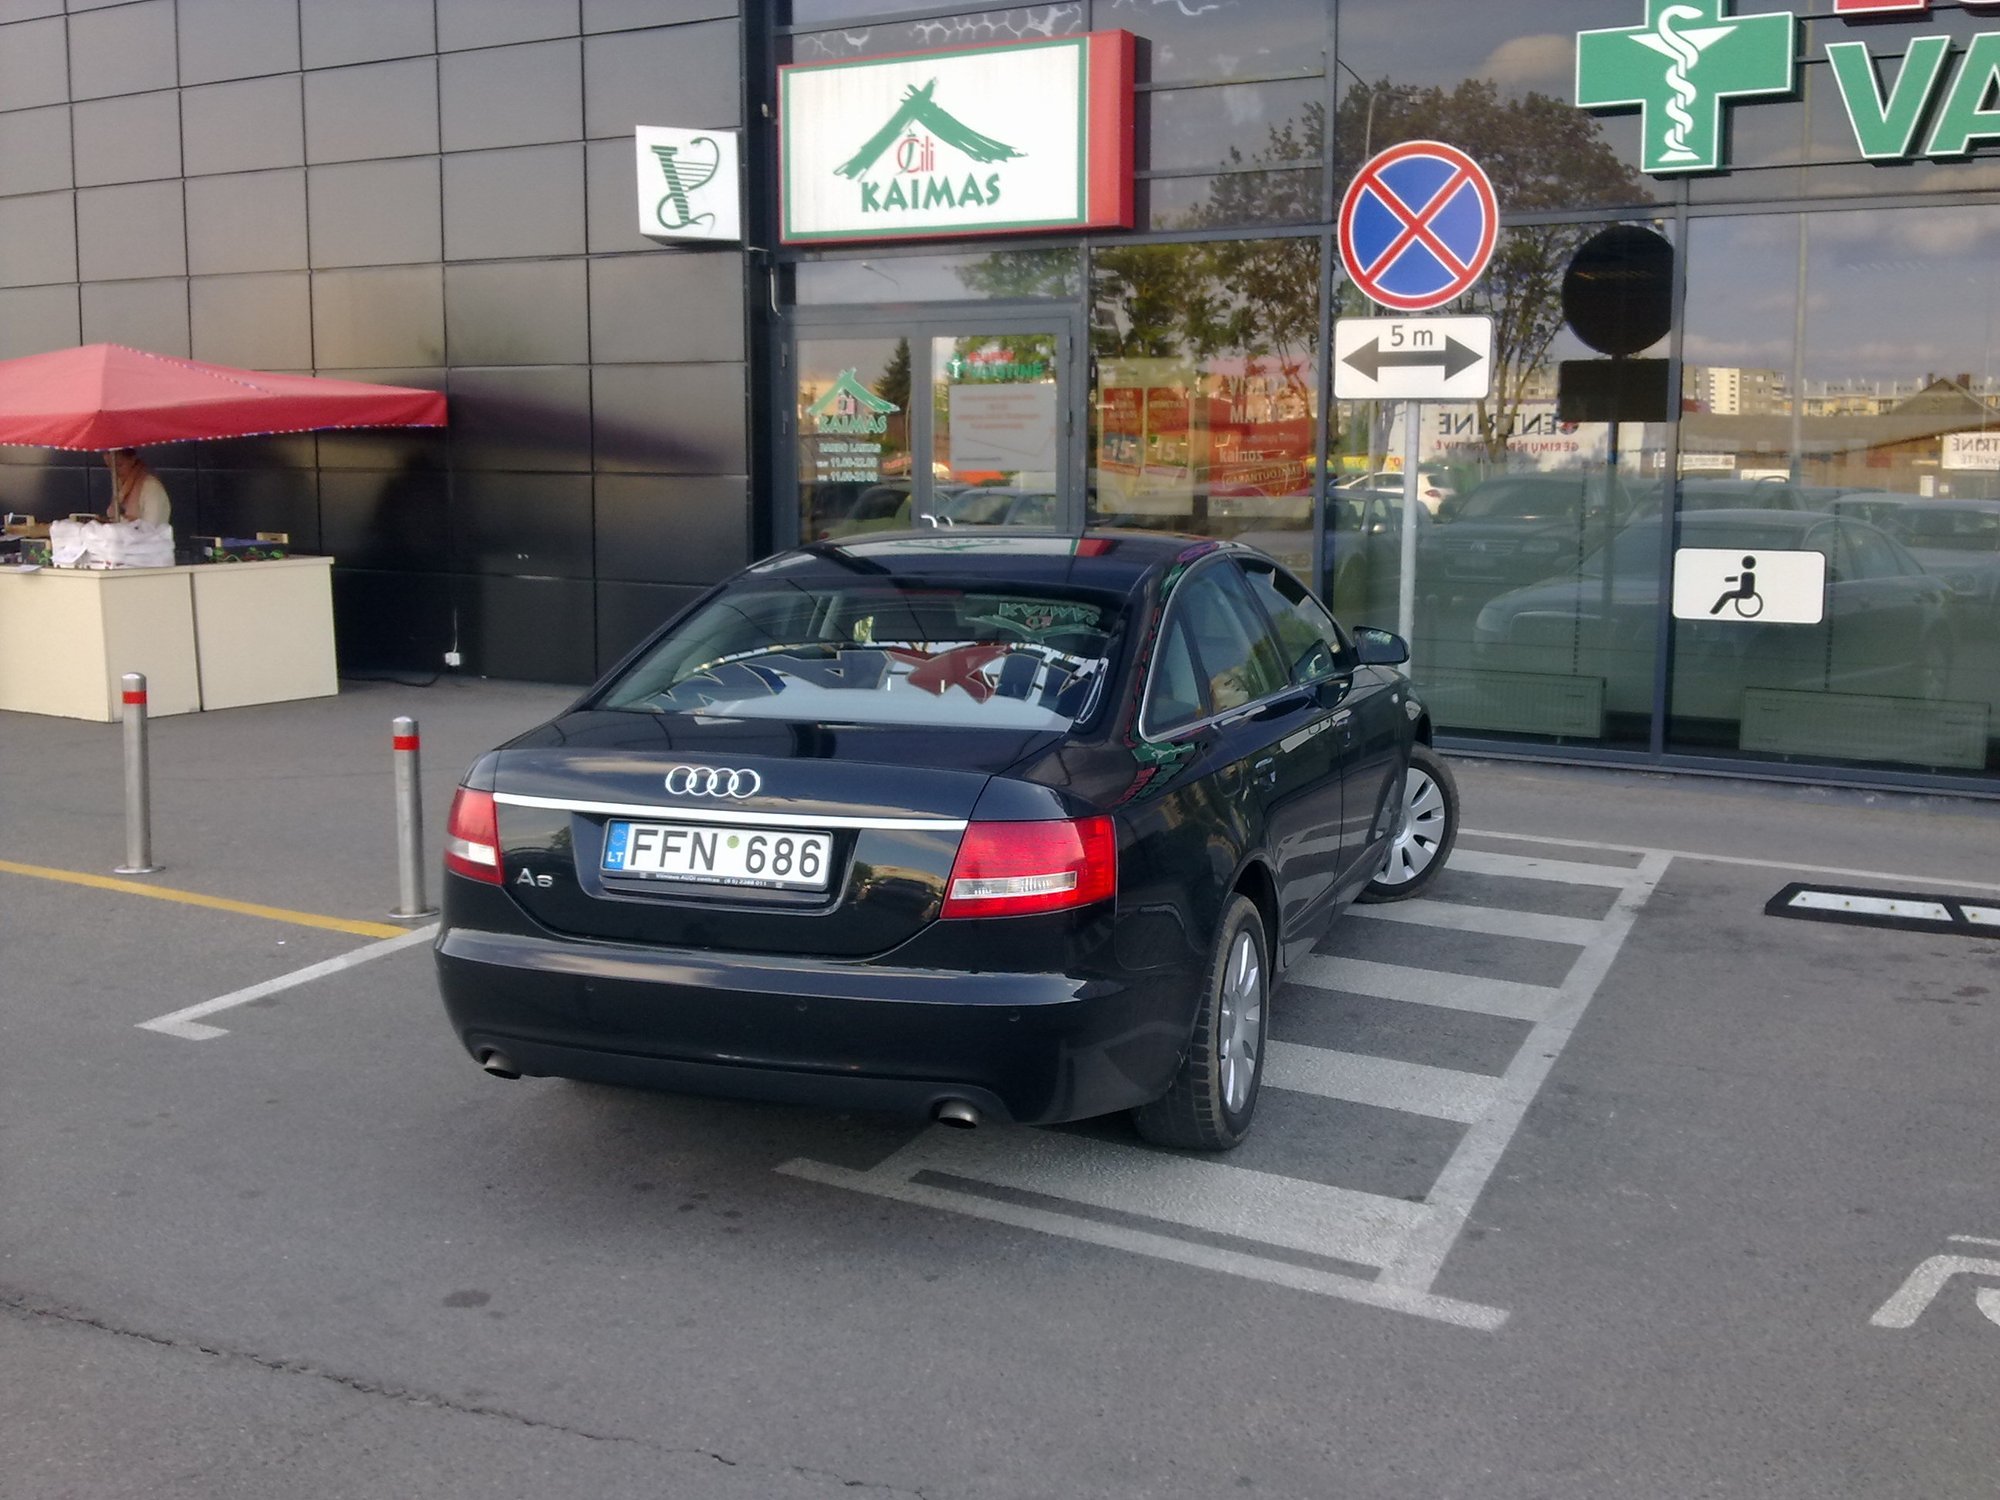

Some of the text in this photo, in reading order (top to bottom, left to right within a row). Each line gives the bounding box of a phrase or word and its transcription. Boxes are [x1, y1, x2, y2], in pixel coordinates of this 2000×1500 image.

[861, 172, 1001, 212] KAIMAS
[1391, 324, 1433, 347] 5 m
[818, 415, 888, 434] KAIMAS
[607, 851, 624, 862] LT
[630, 828, 822, 878] FFN 686
[516, 867, 553, 888] A6
